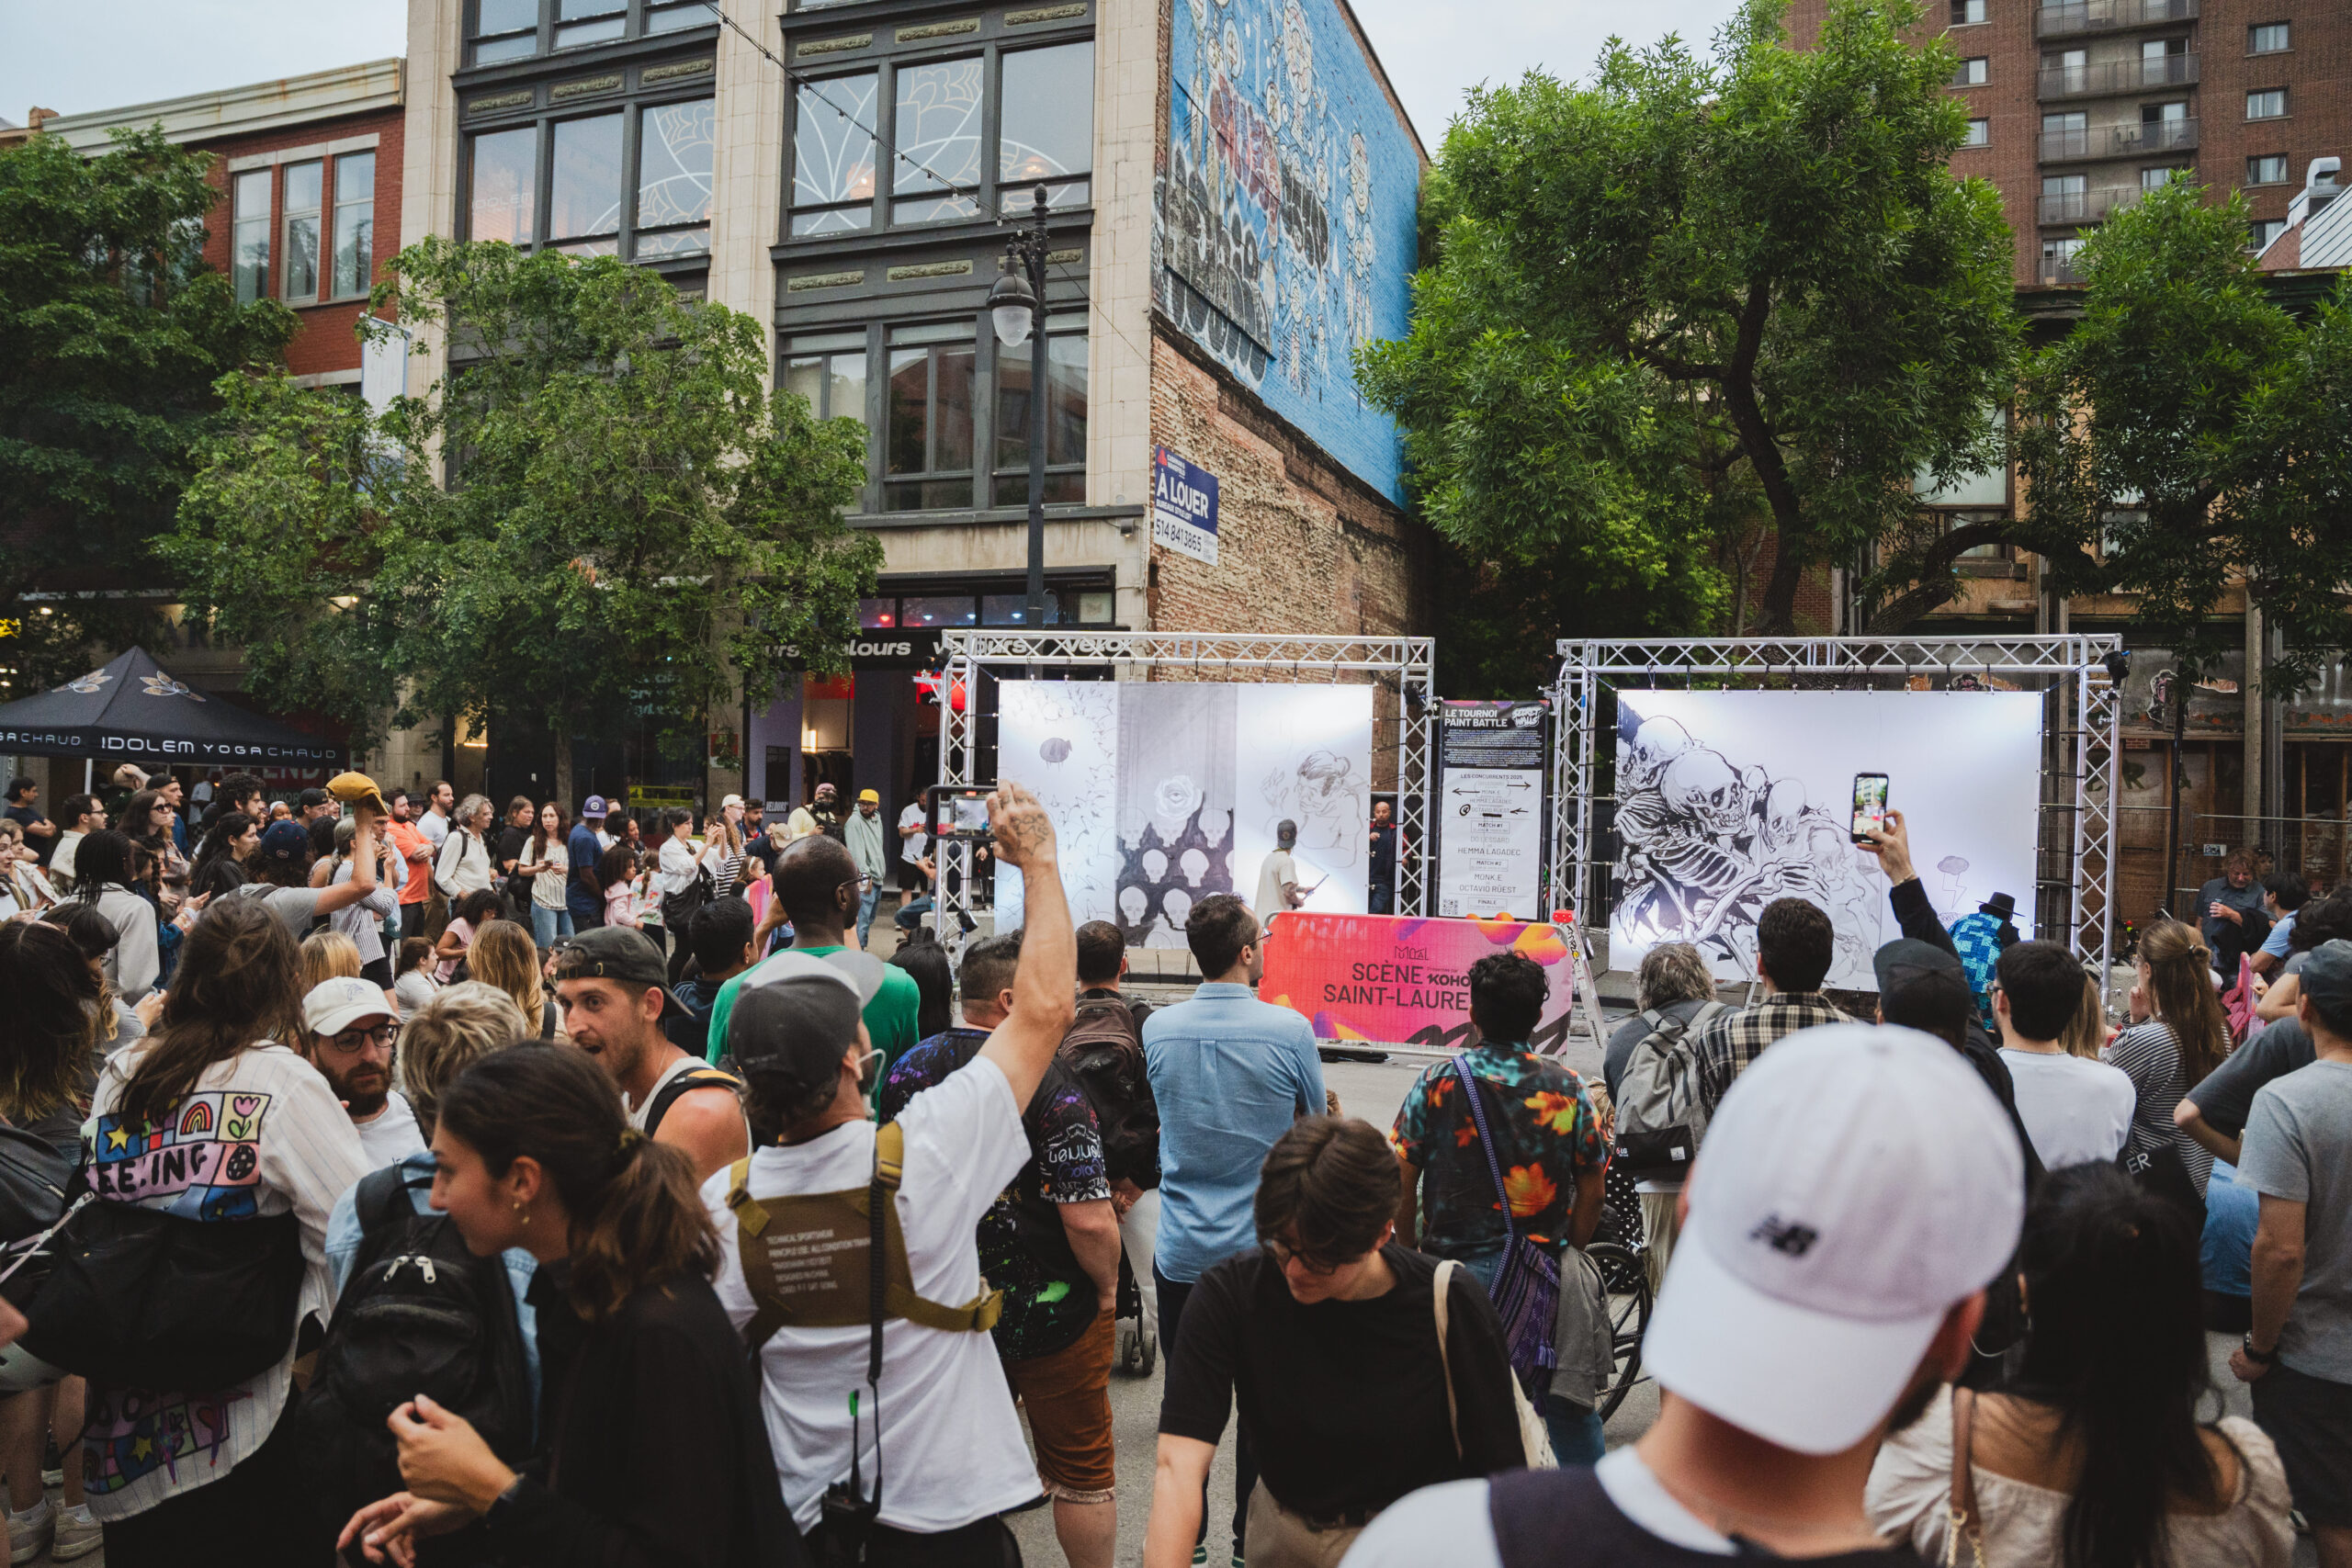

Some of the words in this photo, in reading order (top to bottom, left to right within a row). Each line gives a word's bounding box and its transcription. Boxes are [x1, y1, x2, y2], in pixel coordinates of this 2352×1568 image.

[1157, 468, 1169, 501] À
[1170, 477, 1208, 519] LOUER
[1445, 709, 1457, 717] LE
[1459, 709, 1498, 717] TOURNOI
[1444, 718, 1472, 727] PAINT
[1473, 718, 1508, 728] BATTLE
[101, 737, 194, 754] IDOLEM
[1457, 847, 1485, 855] HEMMA
[1487, 848, 1521, 856] LAGADEC
[1351, 960, 1423, 985] SCÈNE
[1427, 974, 1471, 987] KOHO
[1323, 984, 1469, 1011] SAINT-LAURE
